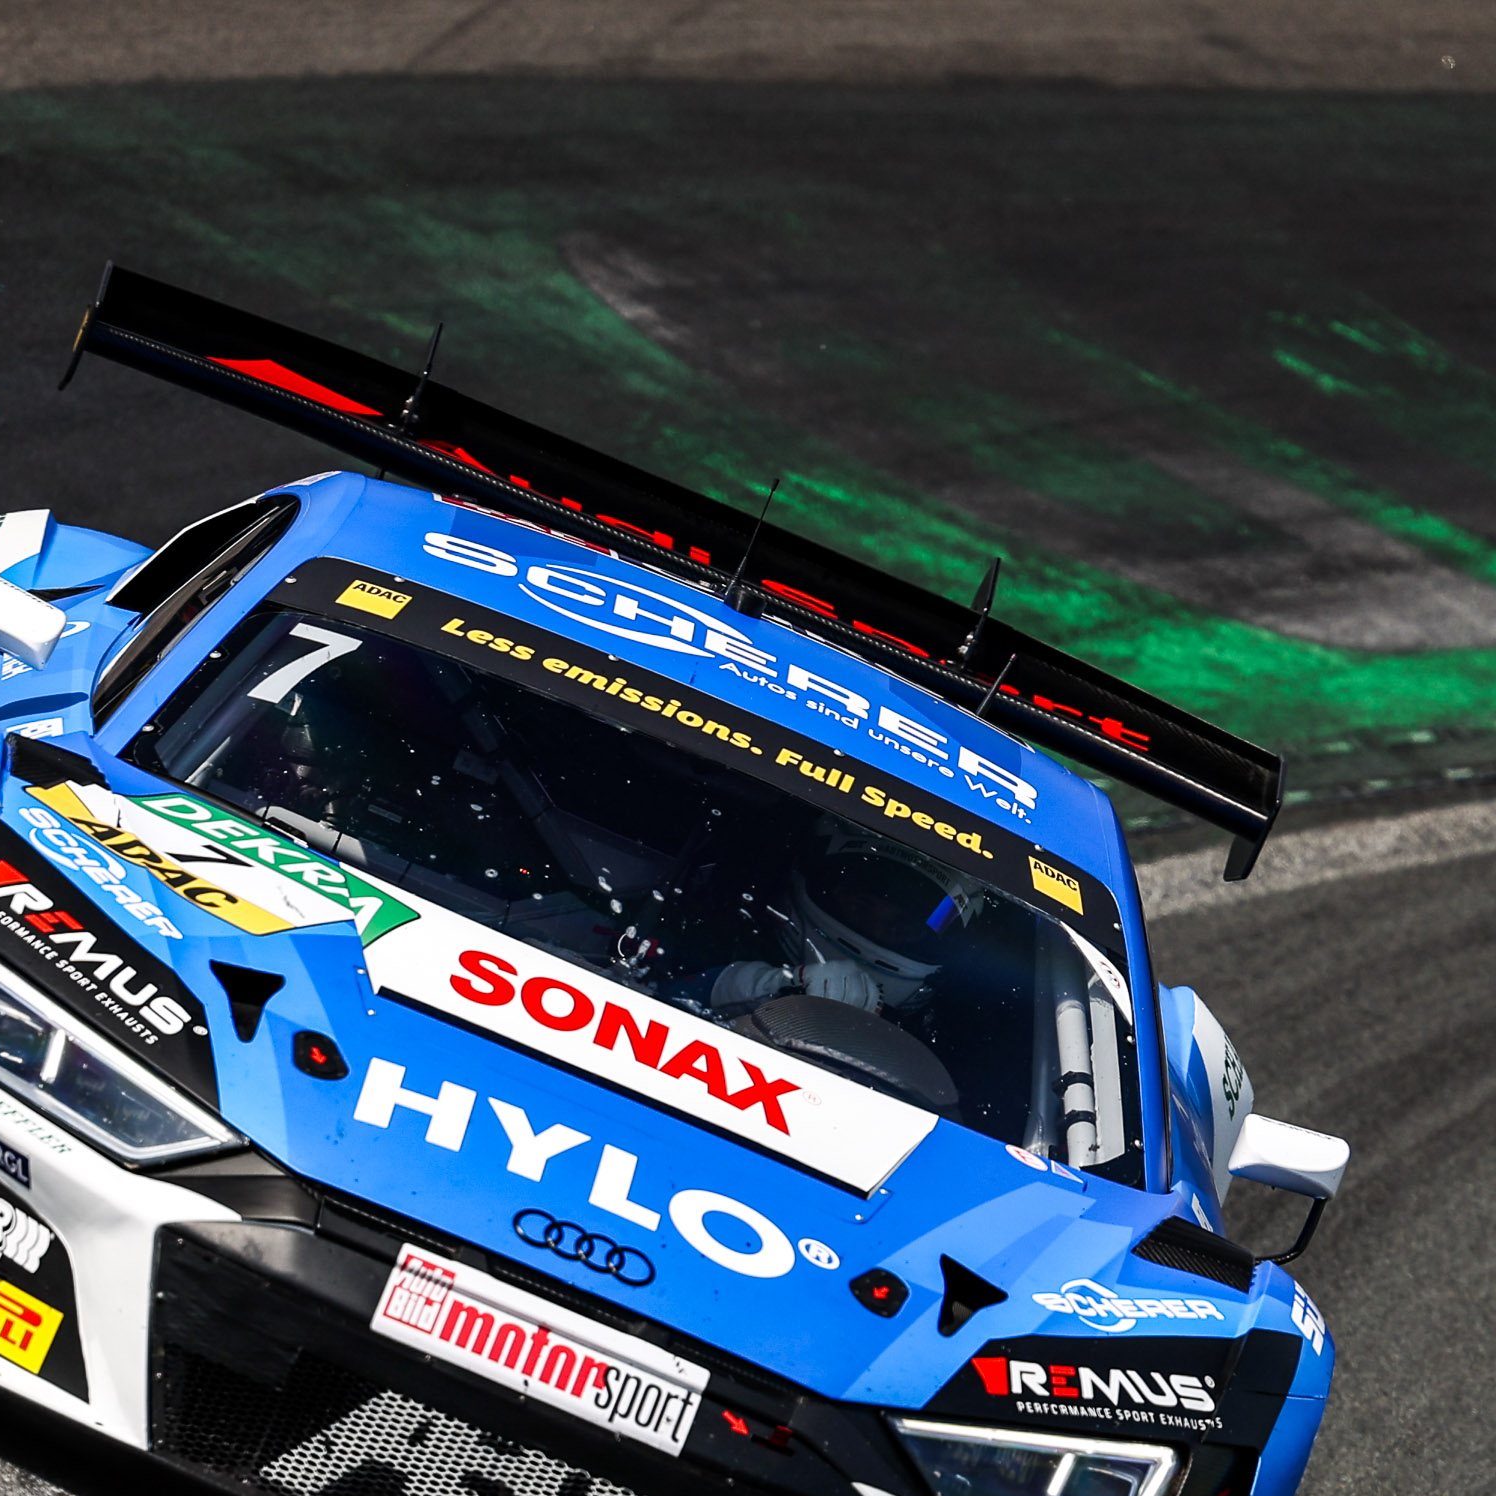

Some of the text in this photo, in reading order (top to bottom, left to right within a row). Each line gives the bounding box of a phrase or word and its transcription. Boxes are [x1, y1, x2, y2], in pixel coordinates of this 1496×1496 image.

[354, 580, 411, 606] ADAC
[248, 622, 363, 705] 7
[422, 532, 1038, 810] SCHERER
[440, 618, 995, 860] Less emissions. Full Speed.
[718, 661, 1032, 825] Autos sind unsere Welt.
[19, 805, 183, 940] SCHERER
[71, 815, 241, 917] ADAC
[152, 796, 383, 926] DEKRA
[169, 842, 255, 868] 7
[1032, 860, 1079, 892] ADAC
[54, 953, 99, 998] SPORT
[93, 986, 158, 1046] EXHAUSTS
[449, 950, 802, 1136] SONAX
[398, 1256, 453, 1300] Auto
[1031, 1291, 1225, 1322] SCHERER
[1009, 1360, 1216, 1413] REMUS
[1016, 1401, 1112, 1420] PERFORMANCE
[1115, 1408, 1156, 1424] SPORT
